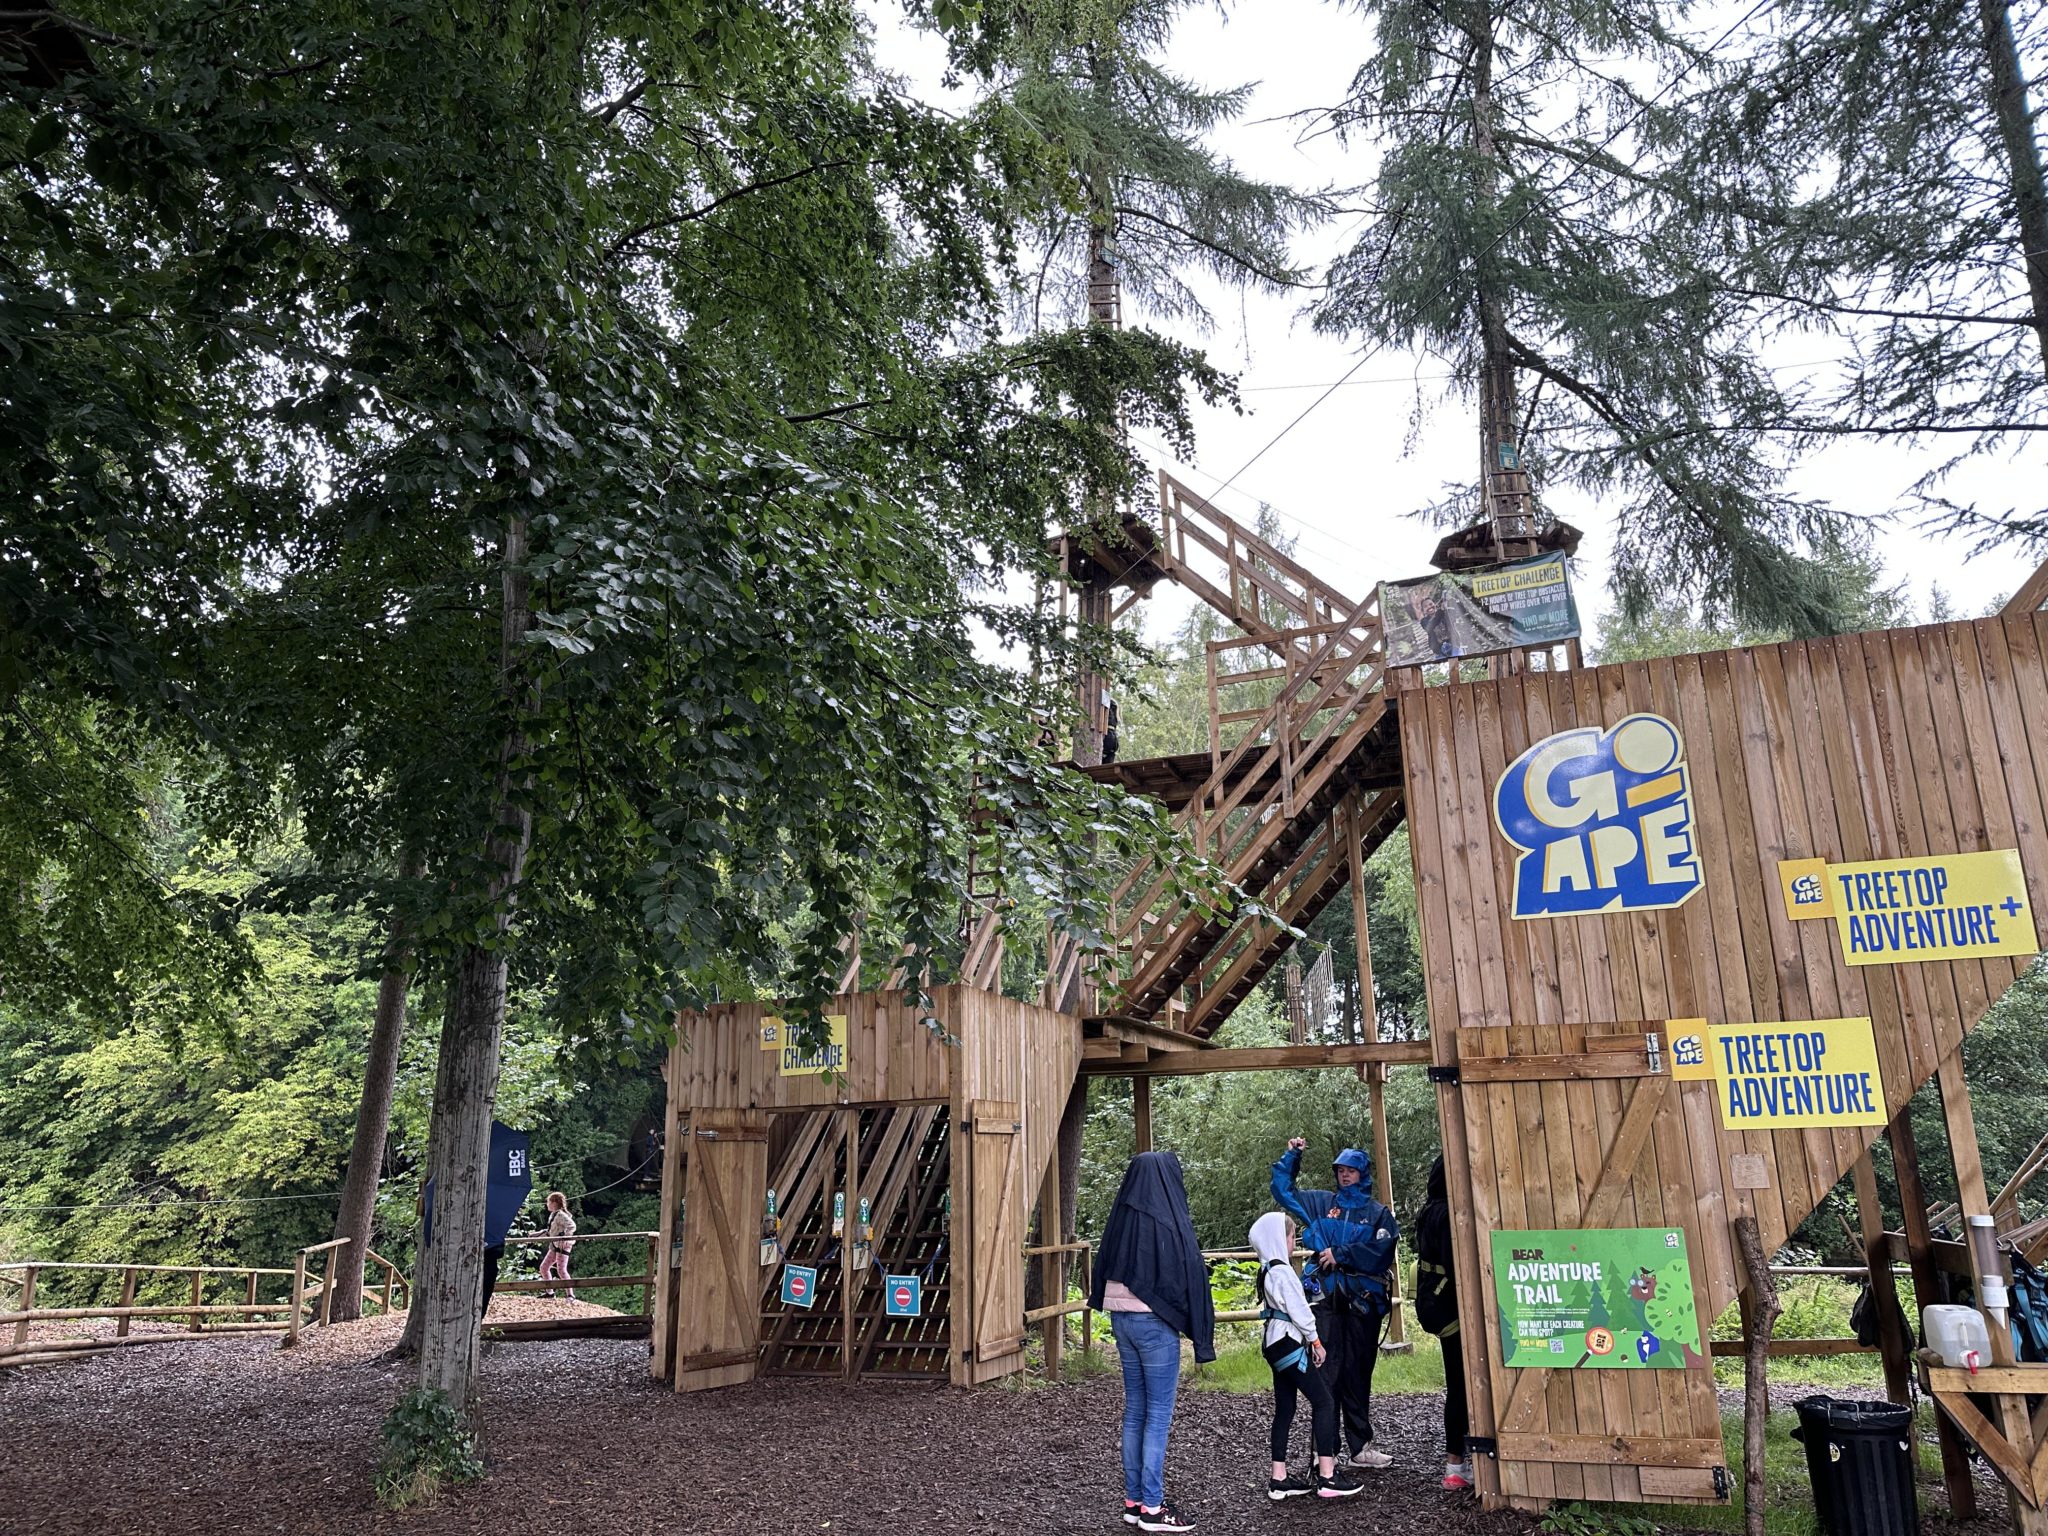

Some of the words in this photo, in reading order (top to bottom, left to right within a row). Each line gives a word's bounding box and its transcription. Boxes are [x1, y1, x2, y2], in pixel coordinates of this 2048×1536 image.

[1476, 576, 1511, 593] TREETOP
[1514, 566, 1560, 587] CHALLENGE
[1489, 594, 1507, 605] HOURS
[1515, 590, 1526, 599] TREE
[1527, 588, 1537, 598] TOP
[1539, 583, 1566, 595] OBSTACLES
[1489, 604, 1500, 614] AND
[1501, 602, 1509, 611] ZIP
[1510, 599, 1526, 610] WIRES
[1527, 597, 1540, 607] OVER
[1542, 594, 1552, 604] THE
[1552, 591, 1567, 602] RIVER
[1522, 614, 1538, 628] FIND
[1549, 609, 1568, 623] MORE
[1542, 802, 1697, 893] APE
[1798, 888, 1823, 902] APE
[1838, 867, 1948, 911] TREETOP
[1850, 904, 2001, 953] ADVENTURE
[1679, 1049, 1704, 1063] APE
[1719, 1031, 1826, 1075] TREETOP
[1729, 1072, 1876, 1118] ADVENTURE
[509, 1150, 521, 1176] EBC
[1512, 1249, 1544, 1260] BEAR
[796, 1270, 811, 1278] ENTRY
[1508, 1262, 1602, 1282] ADVENTURE
[1513, 1284, 1562, 1305] TRAIL
[1517, 1320, 1529, 1328] HOW
[1529, 1320, 1542, 1328] MANY
[1550, 1320, 1563, 1328] EACH
[1563, 1320, 1584, 1328] CREATURE
[1518, 1328, 1528, 1337] CAN
[1529, 1328, 1538, 1337] YOU
[1538, 1328, 1554, 1337] SPOT?
